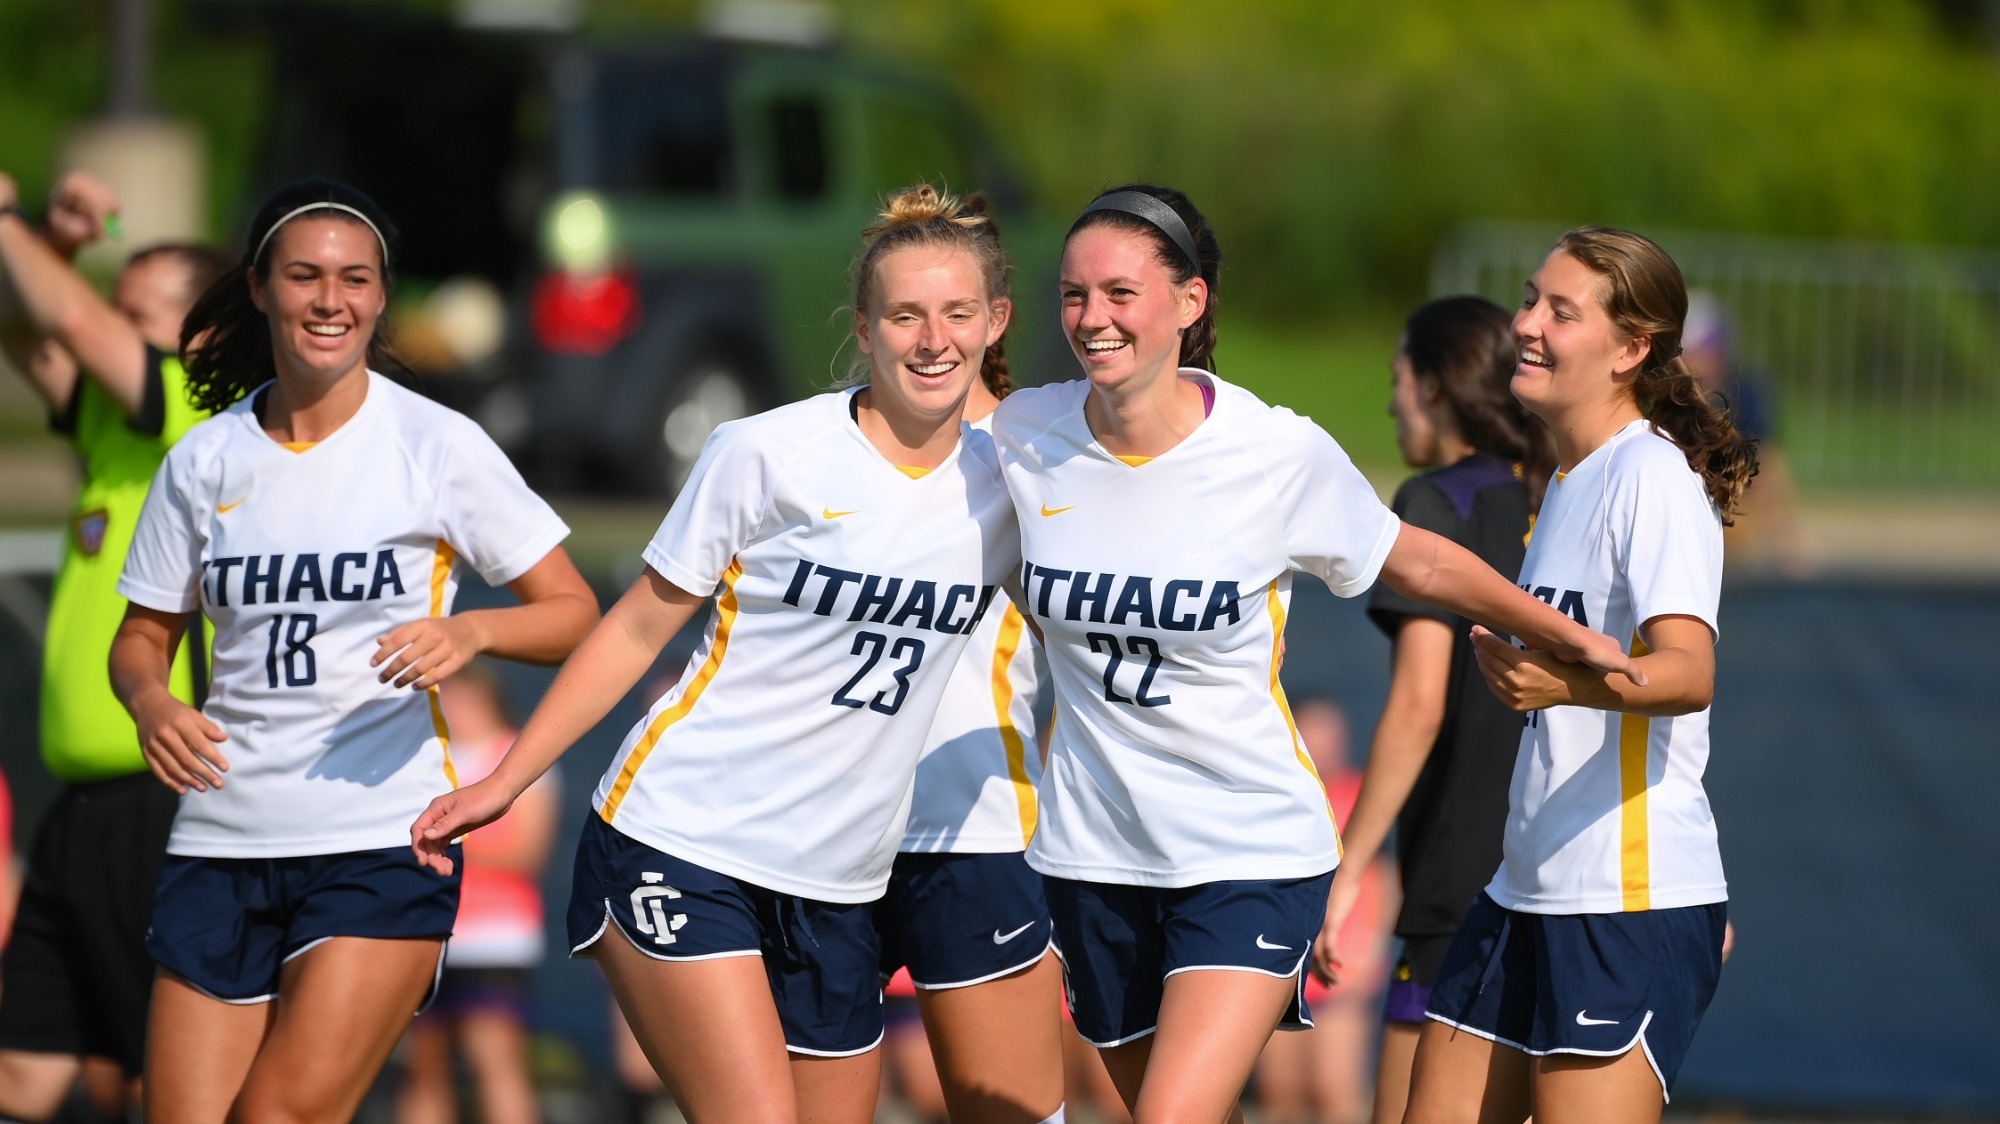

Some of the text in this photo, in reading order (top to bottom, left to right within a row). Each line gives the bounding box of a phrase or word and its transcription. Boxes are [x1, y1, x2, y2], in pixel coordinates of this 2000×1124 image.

[266, 613, 317, 688] 18
[831, 631, 925, 716] 23
[1086, 631, 1172, 708] 22
